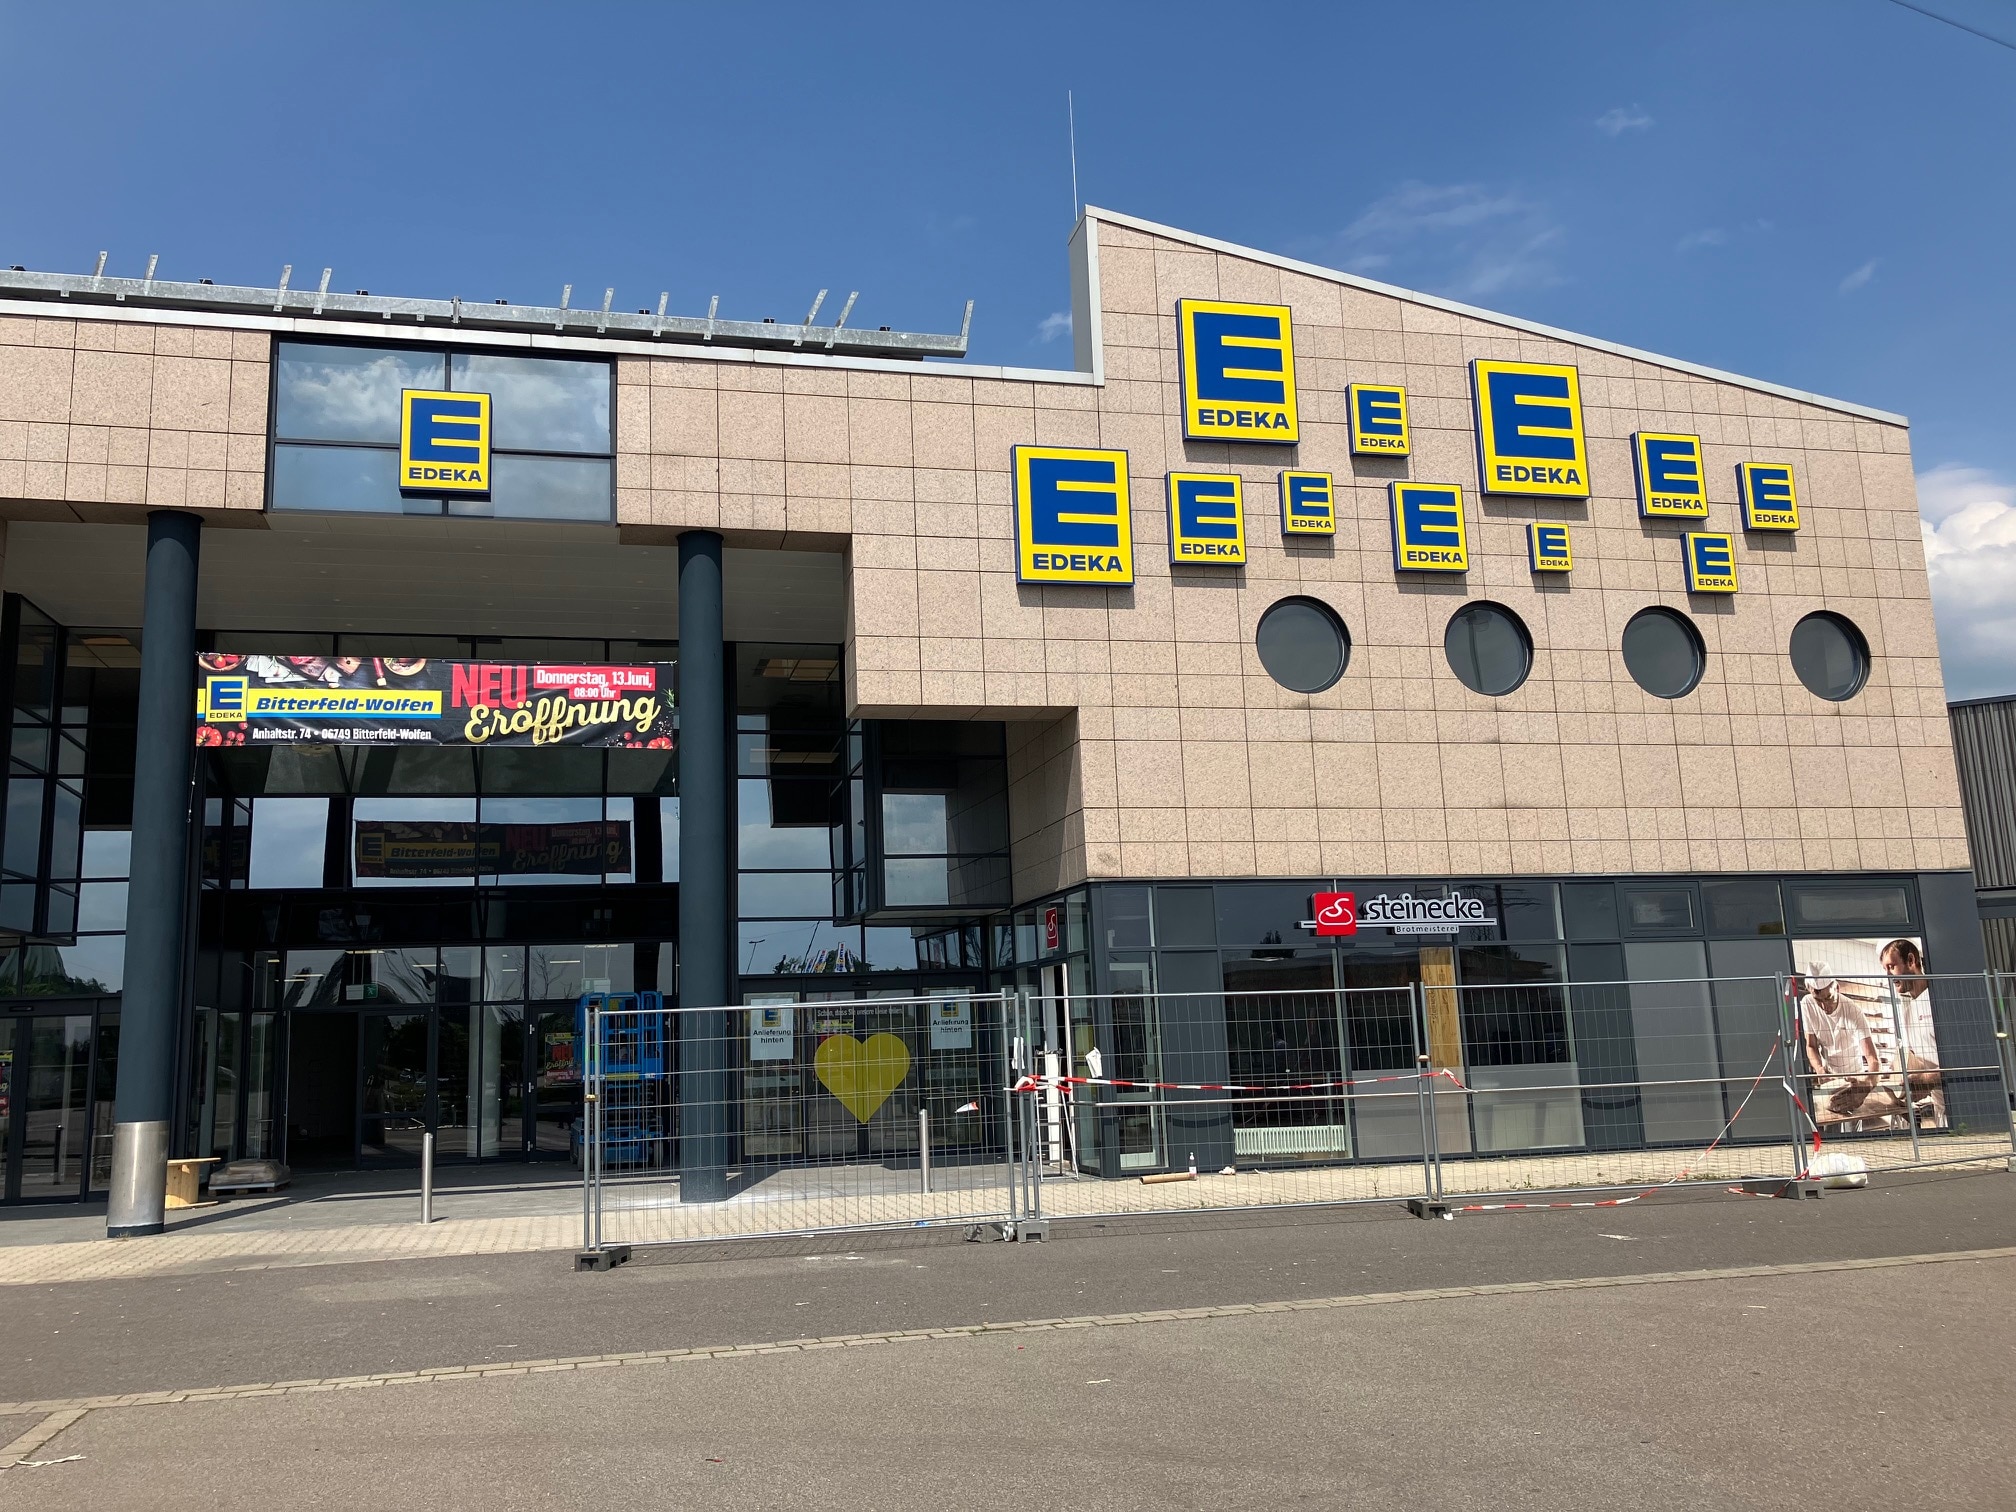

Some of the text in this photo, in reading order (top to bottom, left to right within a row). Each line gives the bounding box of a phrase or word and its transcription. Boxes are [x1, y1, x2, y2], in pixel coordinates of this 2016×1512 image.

[1198, 409, 1289, 429] EDEKA
[1360, 438, 1405, 448] EDEKA
[408, 467, 481, 482] EDEKA
[1496, 465, 1580, 484] EDEKA
[1651, 498, 1702, 509] EDEKA
[1291, 520, 1331, 528] EDEKA
[1754, 514, 1794, 523] EDEKA
[1180, 544, 1240, 555] EDEKA
[1032, 554, 1122, 572] EDEKA
[1406, 551, 1462, 563] EDEKA
[537, 669, 653, 688] Donnerstag, 13.Juni,
[451, 664, 527, 709] NEU
[574, 688, 617, 698] 08:00 Uhr
[256, 697, 434, 711] Bitterfeld-Wolfen
[464, 696, 661, 745] Eröffnung
[252, 727, 432, 740] Anhaltstr. 74 06749 Bitterfeld-Wolfen
[390, 848, 496, 858] Bitterfeld-Wolen
[1368, 894, 1483, 920] steinecke
